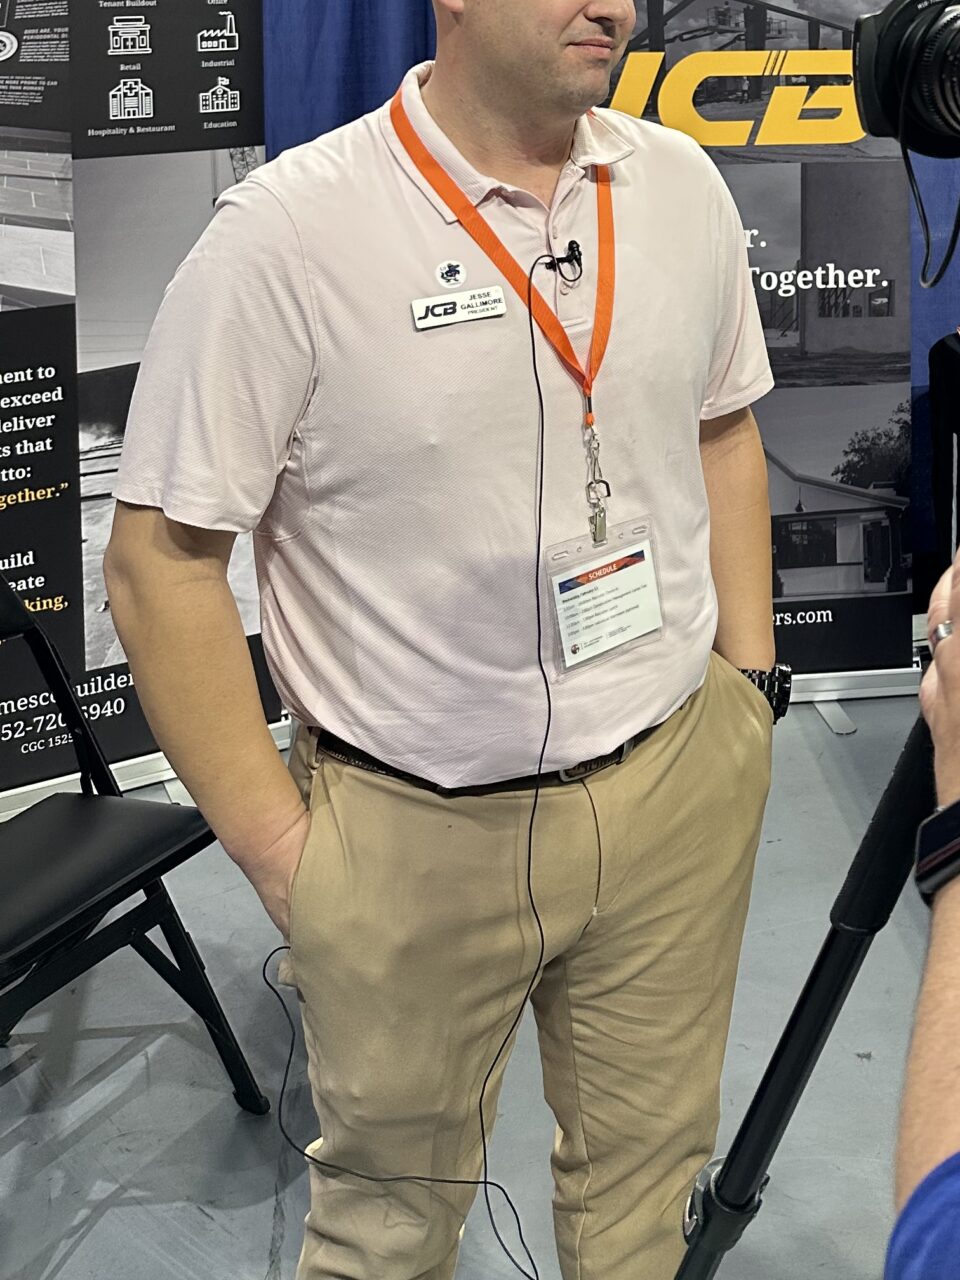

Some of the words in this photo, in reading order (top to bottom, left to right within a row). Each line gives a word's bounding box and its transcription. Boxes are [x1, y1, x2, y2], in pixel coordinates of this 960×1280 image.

[126, 0, 157, 7] Buildout
[120, 63, 141, 71] Retail
[201, 59, 235, 68] Industrial
[204, 120, 238, 129] Education
[88, 128, 127, 137] Hospitality
[136, 125, 176, 133] Restaurant
[469, 292, 491, 301] JESSE
[417, 301, 457, 321] JCB
[460, 298, 503, 310] GALLIMORE
[37, 366, 56, 379] to
[0, 387, 63, 408] exceed
[15, 438, 53, 455] that
[588, 564, 618, 581] SCHEDULE
[21, 740, 45, 754] CGC
